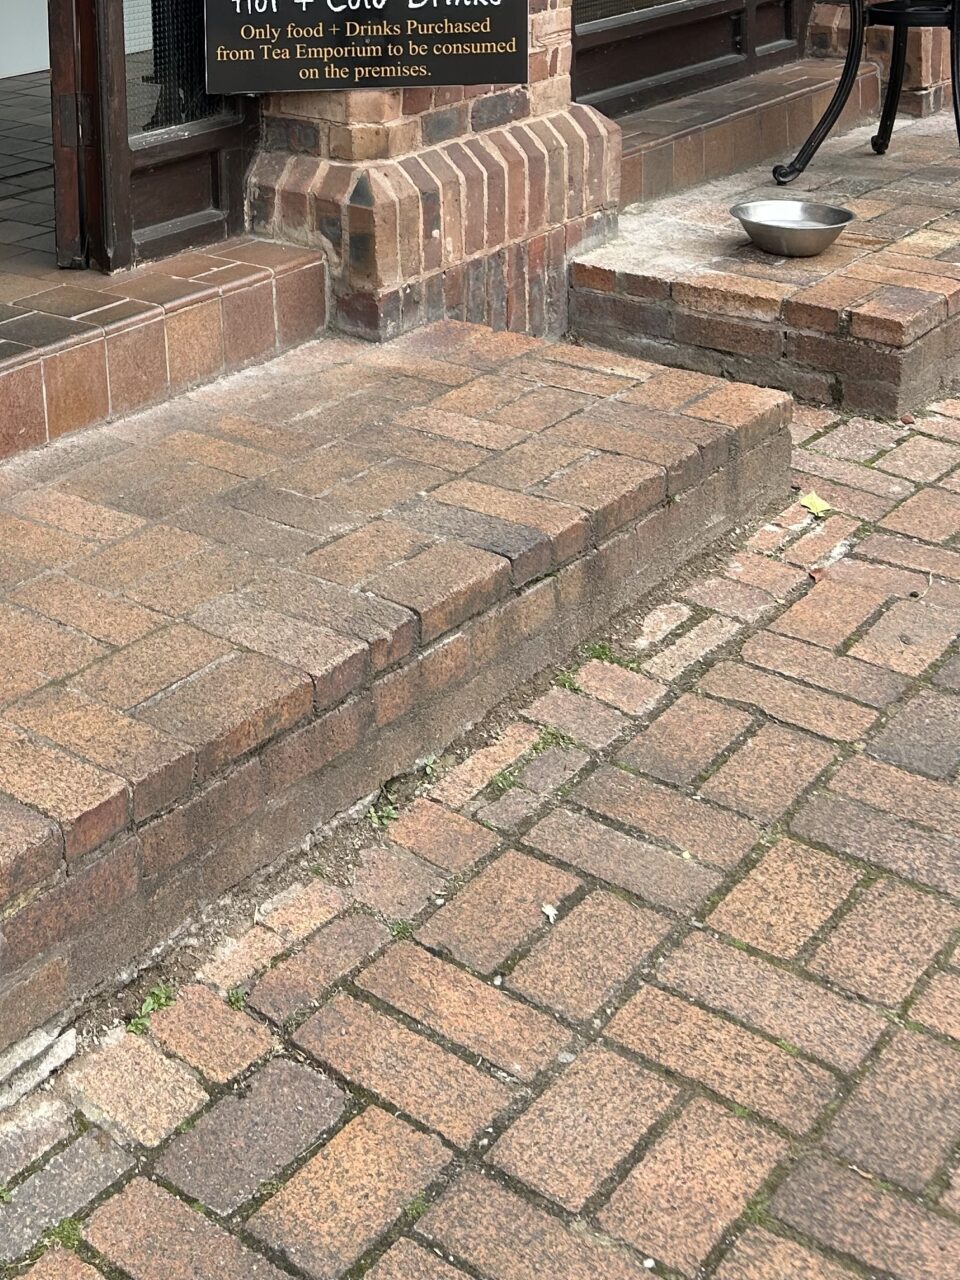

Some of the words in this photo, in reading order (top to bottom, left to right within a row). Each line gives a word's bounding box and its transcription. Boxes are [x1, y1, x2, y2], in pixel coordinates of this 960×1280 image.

[240, 23, 281, 43] Only
[286, 21, 324, 39] food
[328, 24, 341, 37] +
[345, 20, 401, 37] Drinks
[406, 17, 492, 35] Purchased
[216, 45, 255, 61] from
[260, 44, 290, 61] Tea
[295, 41, 383, 63] Emporium
[387, 41, 402, 57] to
[408, 38, 429, 56] be
[432, 37, 517, 55] consumed
[298, 67, 319, 80] on
[324, 61, 349, 79] the
[354, 62, 432, 82] premises.
